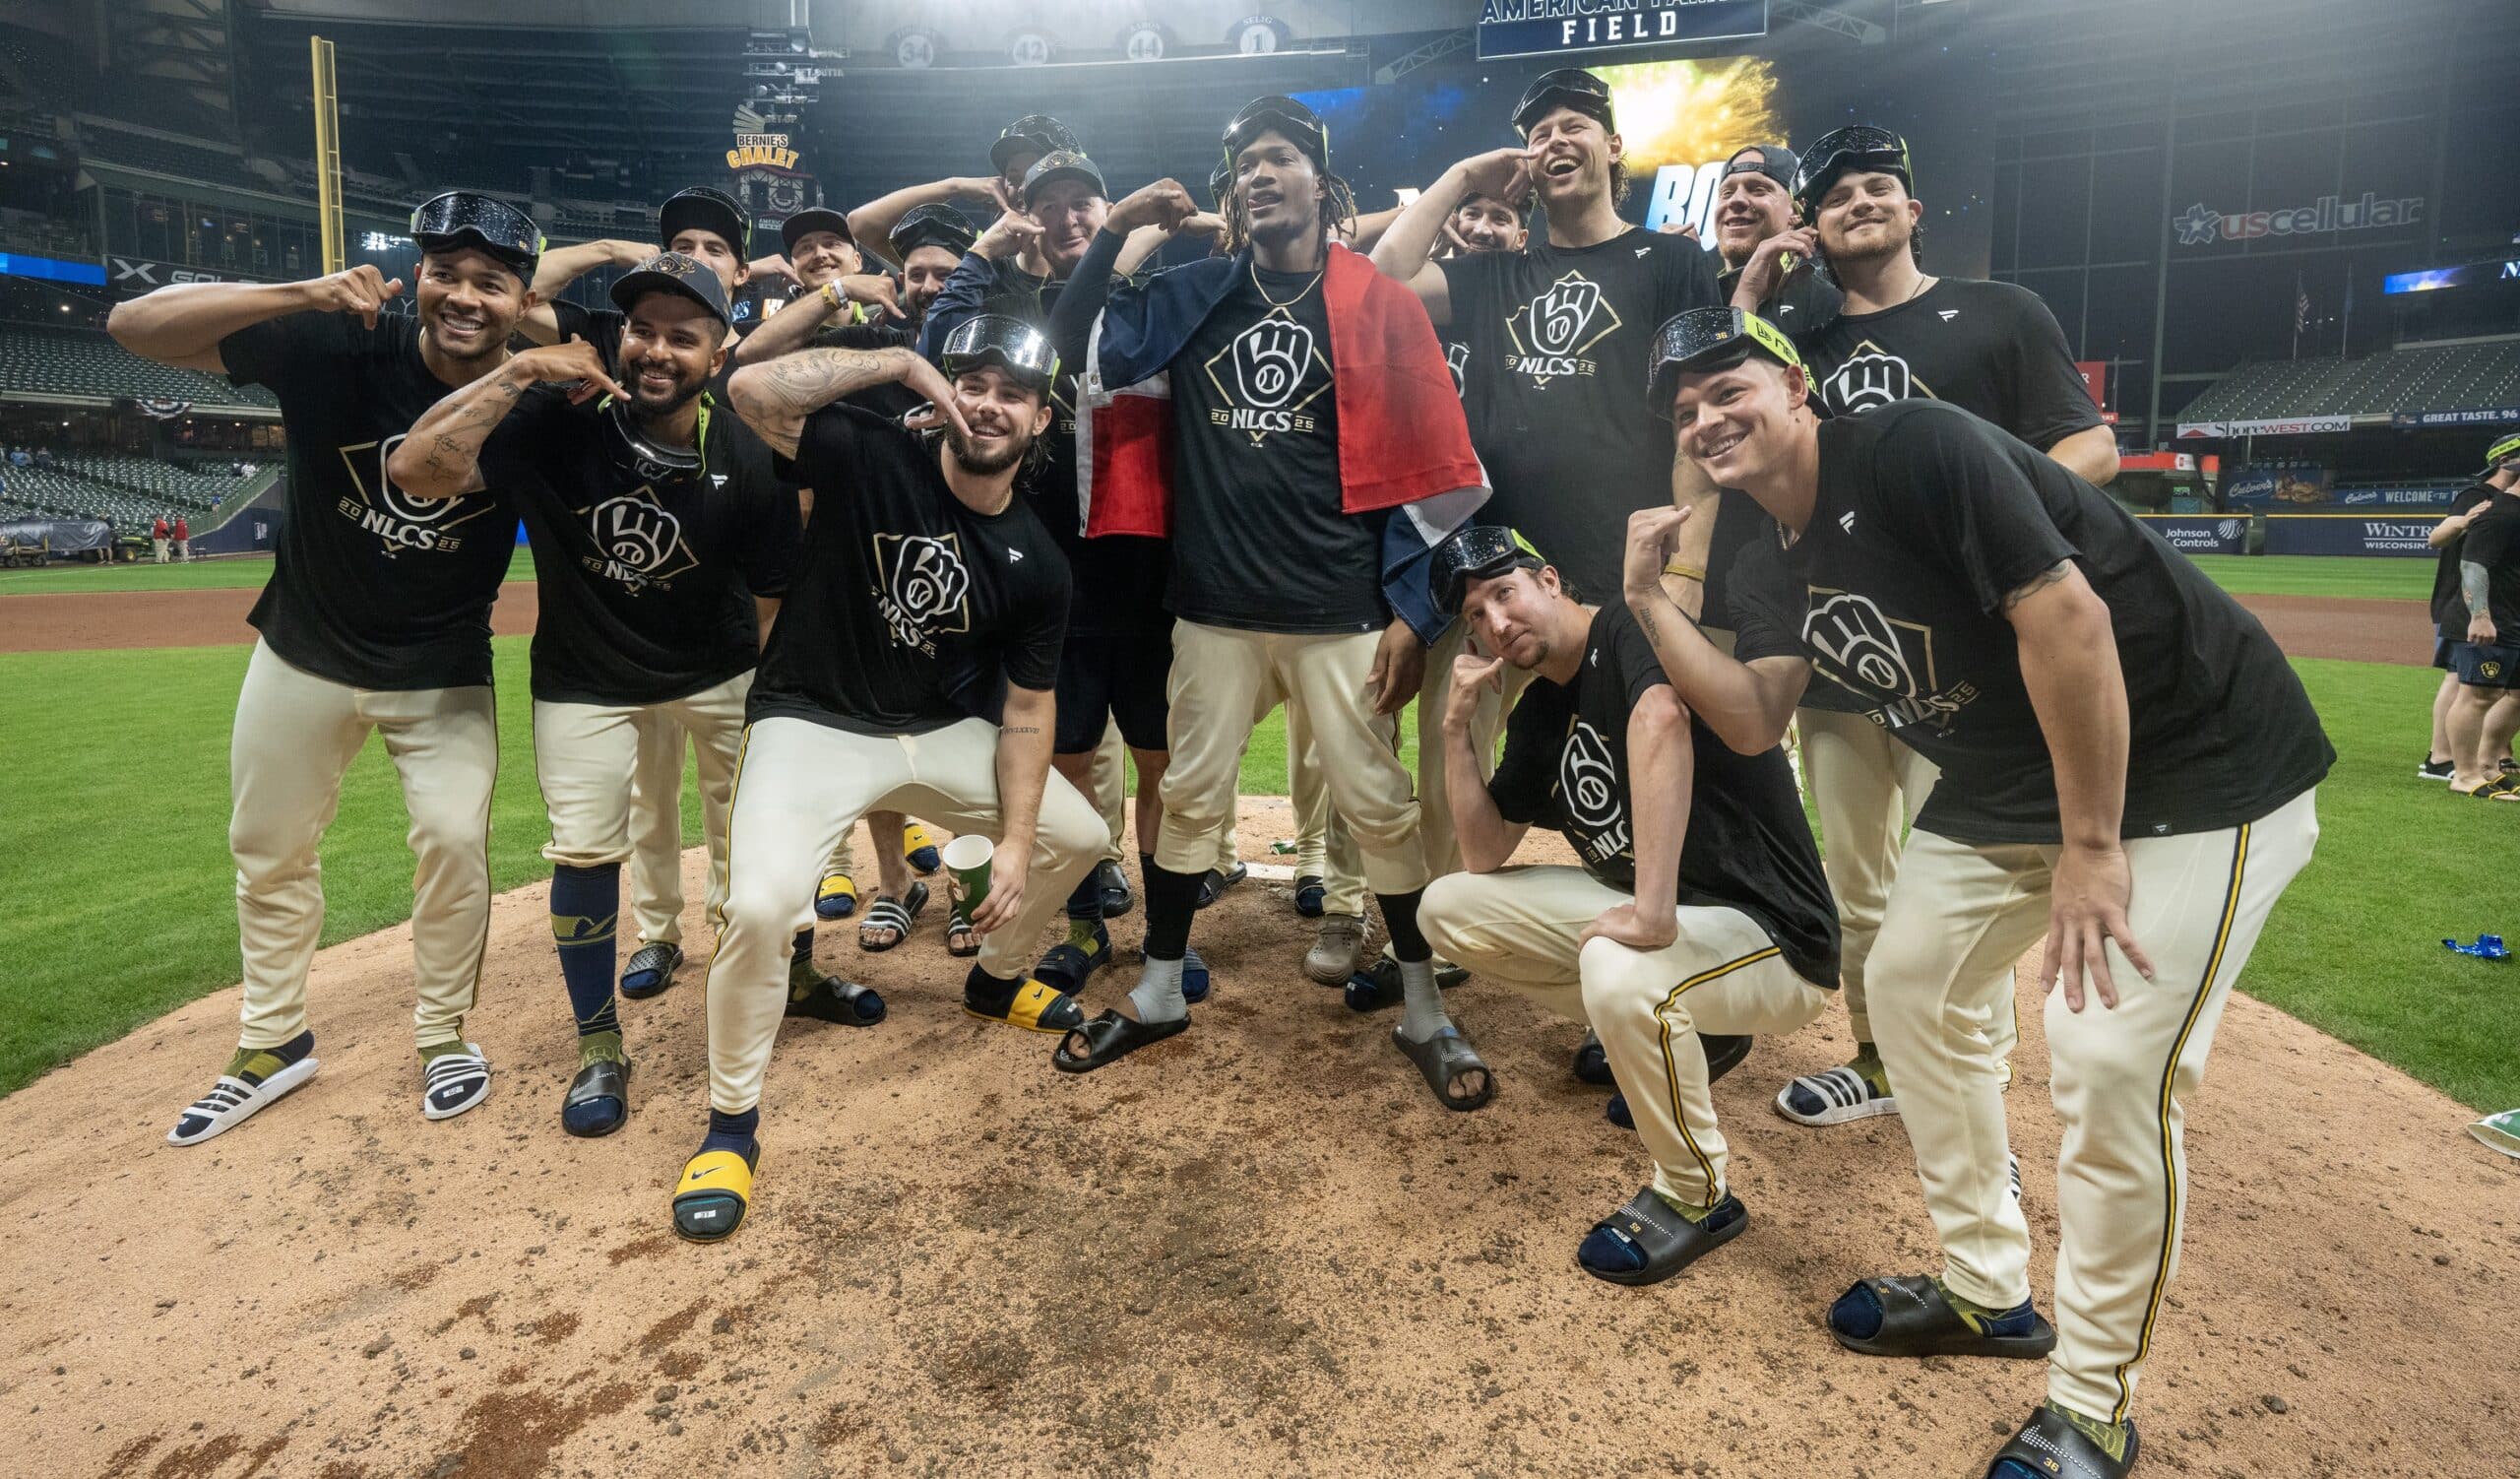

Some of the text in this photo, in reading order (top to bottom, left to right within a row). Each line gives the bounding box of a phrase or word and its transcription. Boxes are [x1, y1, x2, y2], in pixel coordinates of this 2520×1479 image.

[1244, 16, 1274, 25] SELIG
[1562, 11, 1675, 44] FIELD
[1253, 31, 1262, 52] 1
[737, 134, 788, 148] BERNIE'S
[725, 147, 799, 169] CHALET
[2221, 192, 2424, 240] uscellular
[1517, 356, 1577, 375] NLCS
[1211, 409, 1314, 432] 20 NLCS 25
[2423, 413, 2458, 423] GREAT
[2462, 411, 2498, 420] TASTE.
[2502, 409, 2518, 418] 96
[2385, 490, 2433, 503] WELCOME
[339, 500, 461, 550] 20 NLCS 25
[2166, 527, 2211, 539] Johnson
[2365, 522, 2436, 537] WINTR
[2173, 538, 2219, 547] Controls
[1592, 820, 1630, 860] NLC
[2043, 1456, 2060, 1472] 36
